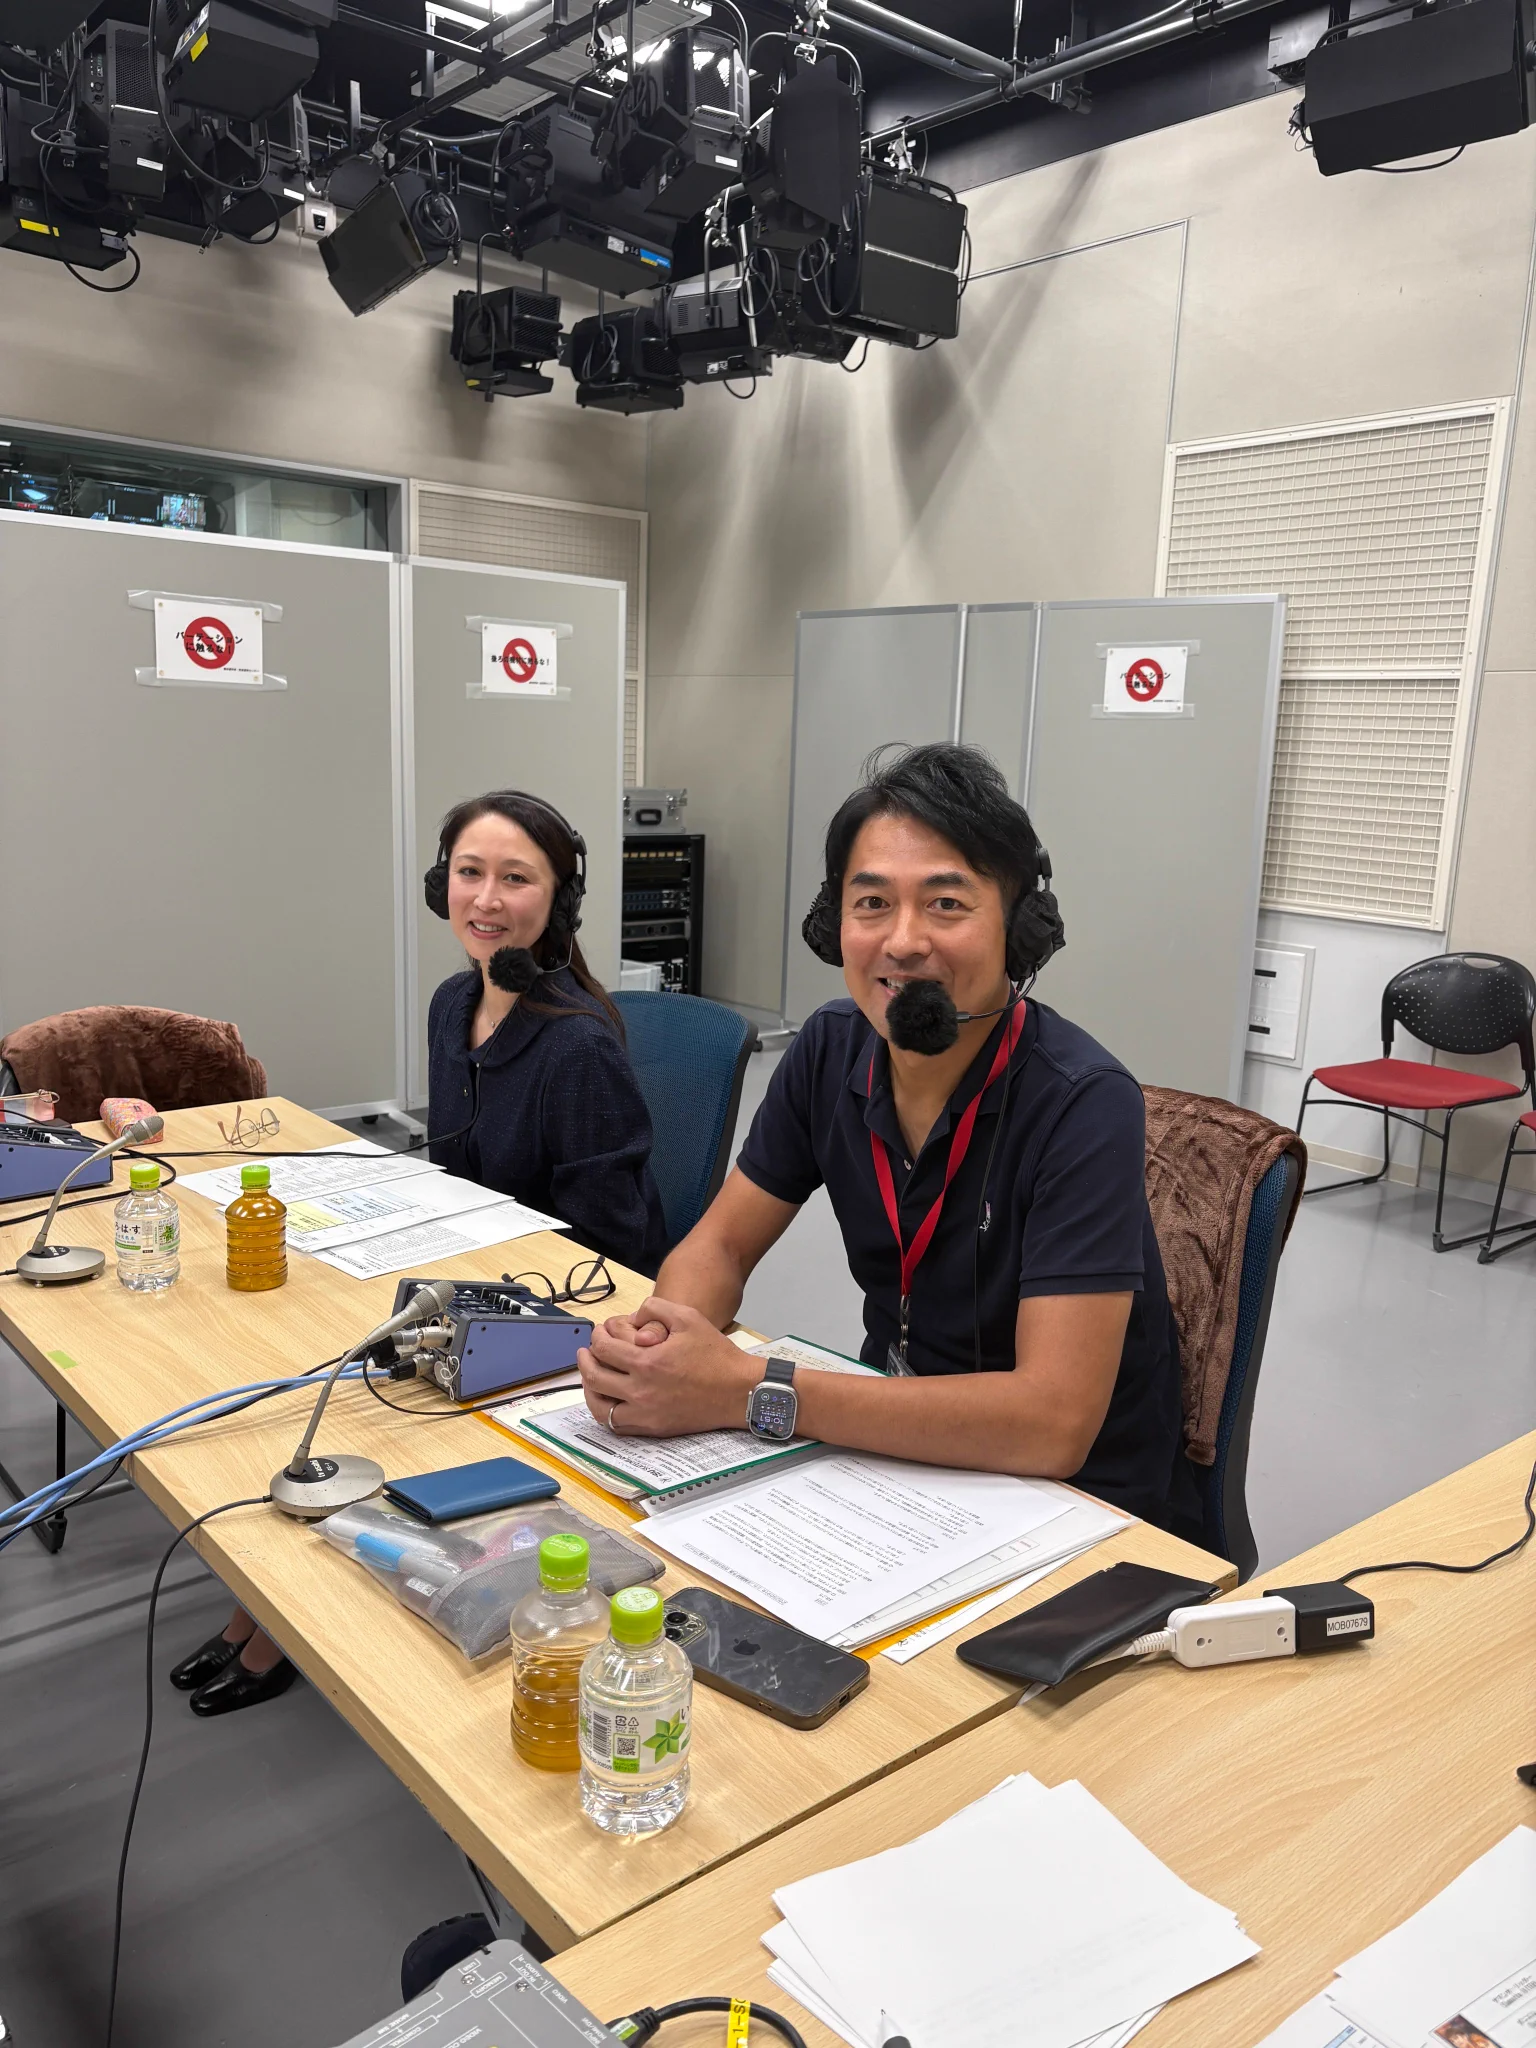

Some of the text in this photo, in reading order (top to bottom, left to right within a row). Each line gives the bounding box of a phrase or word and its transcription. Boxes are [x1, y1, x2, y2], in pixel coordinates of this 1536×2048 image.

[1327, 1616, 1369, 1632] MOB07679
[475, 1975, 502, 1995] MEMORY
[552, 1989, 569, 2004] VIDEO
[389, 2026, 422, 2047] CONTROL
[460, 2028, 482, 2044] VIDEO
